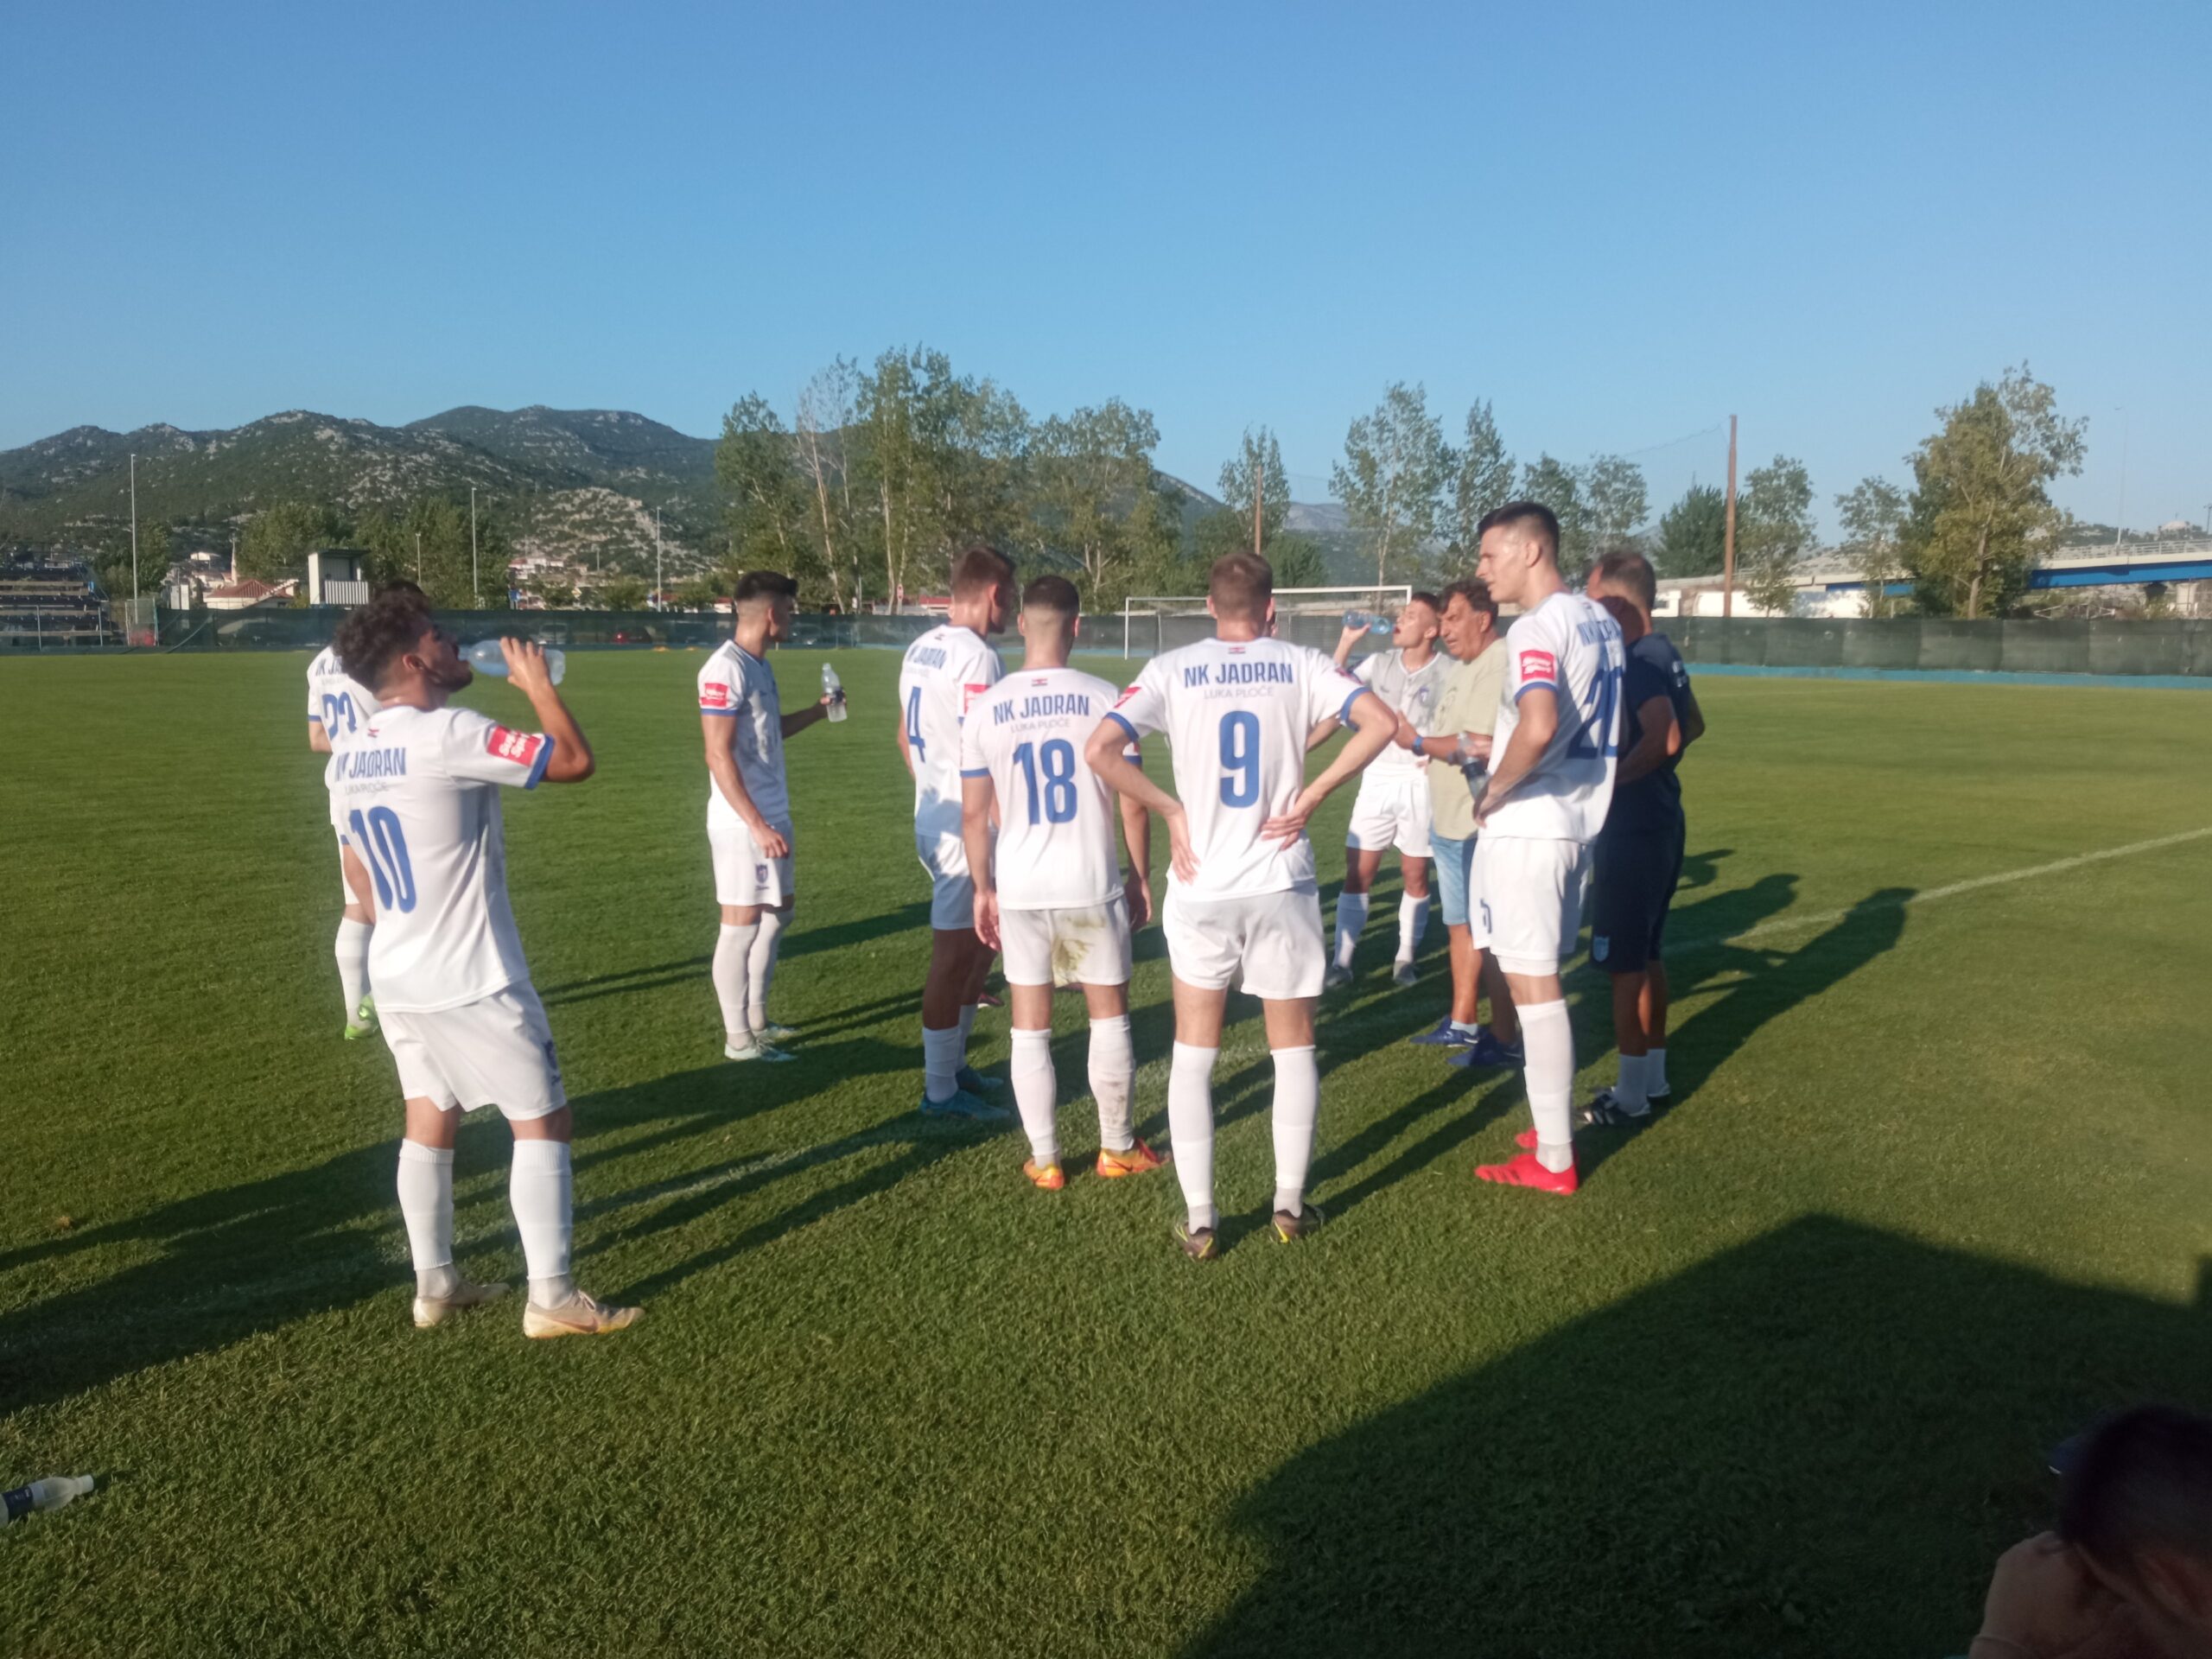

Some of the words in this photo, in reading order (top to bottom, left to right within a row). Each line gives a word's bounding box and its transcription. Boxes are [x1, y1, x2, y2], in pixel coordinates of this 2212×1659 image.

[1184, 664, 1209, 689] NK
[1215, 662, 1294, 684] JADRAN
[1204, 689, 1233, 699] LUKA
[906, 686, 925, 763] 4
[994, 699, 1015, 727] NK
[1020, 694, 1090, 718] JADRAN
[349, 747, 406, 779] JADRAN
[1013, 739, 1077, 826] 18
[1219, 710, 1261, 809] 9
[348, 805, 416, 914] 10
